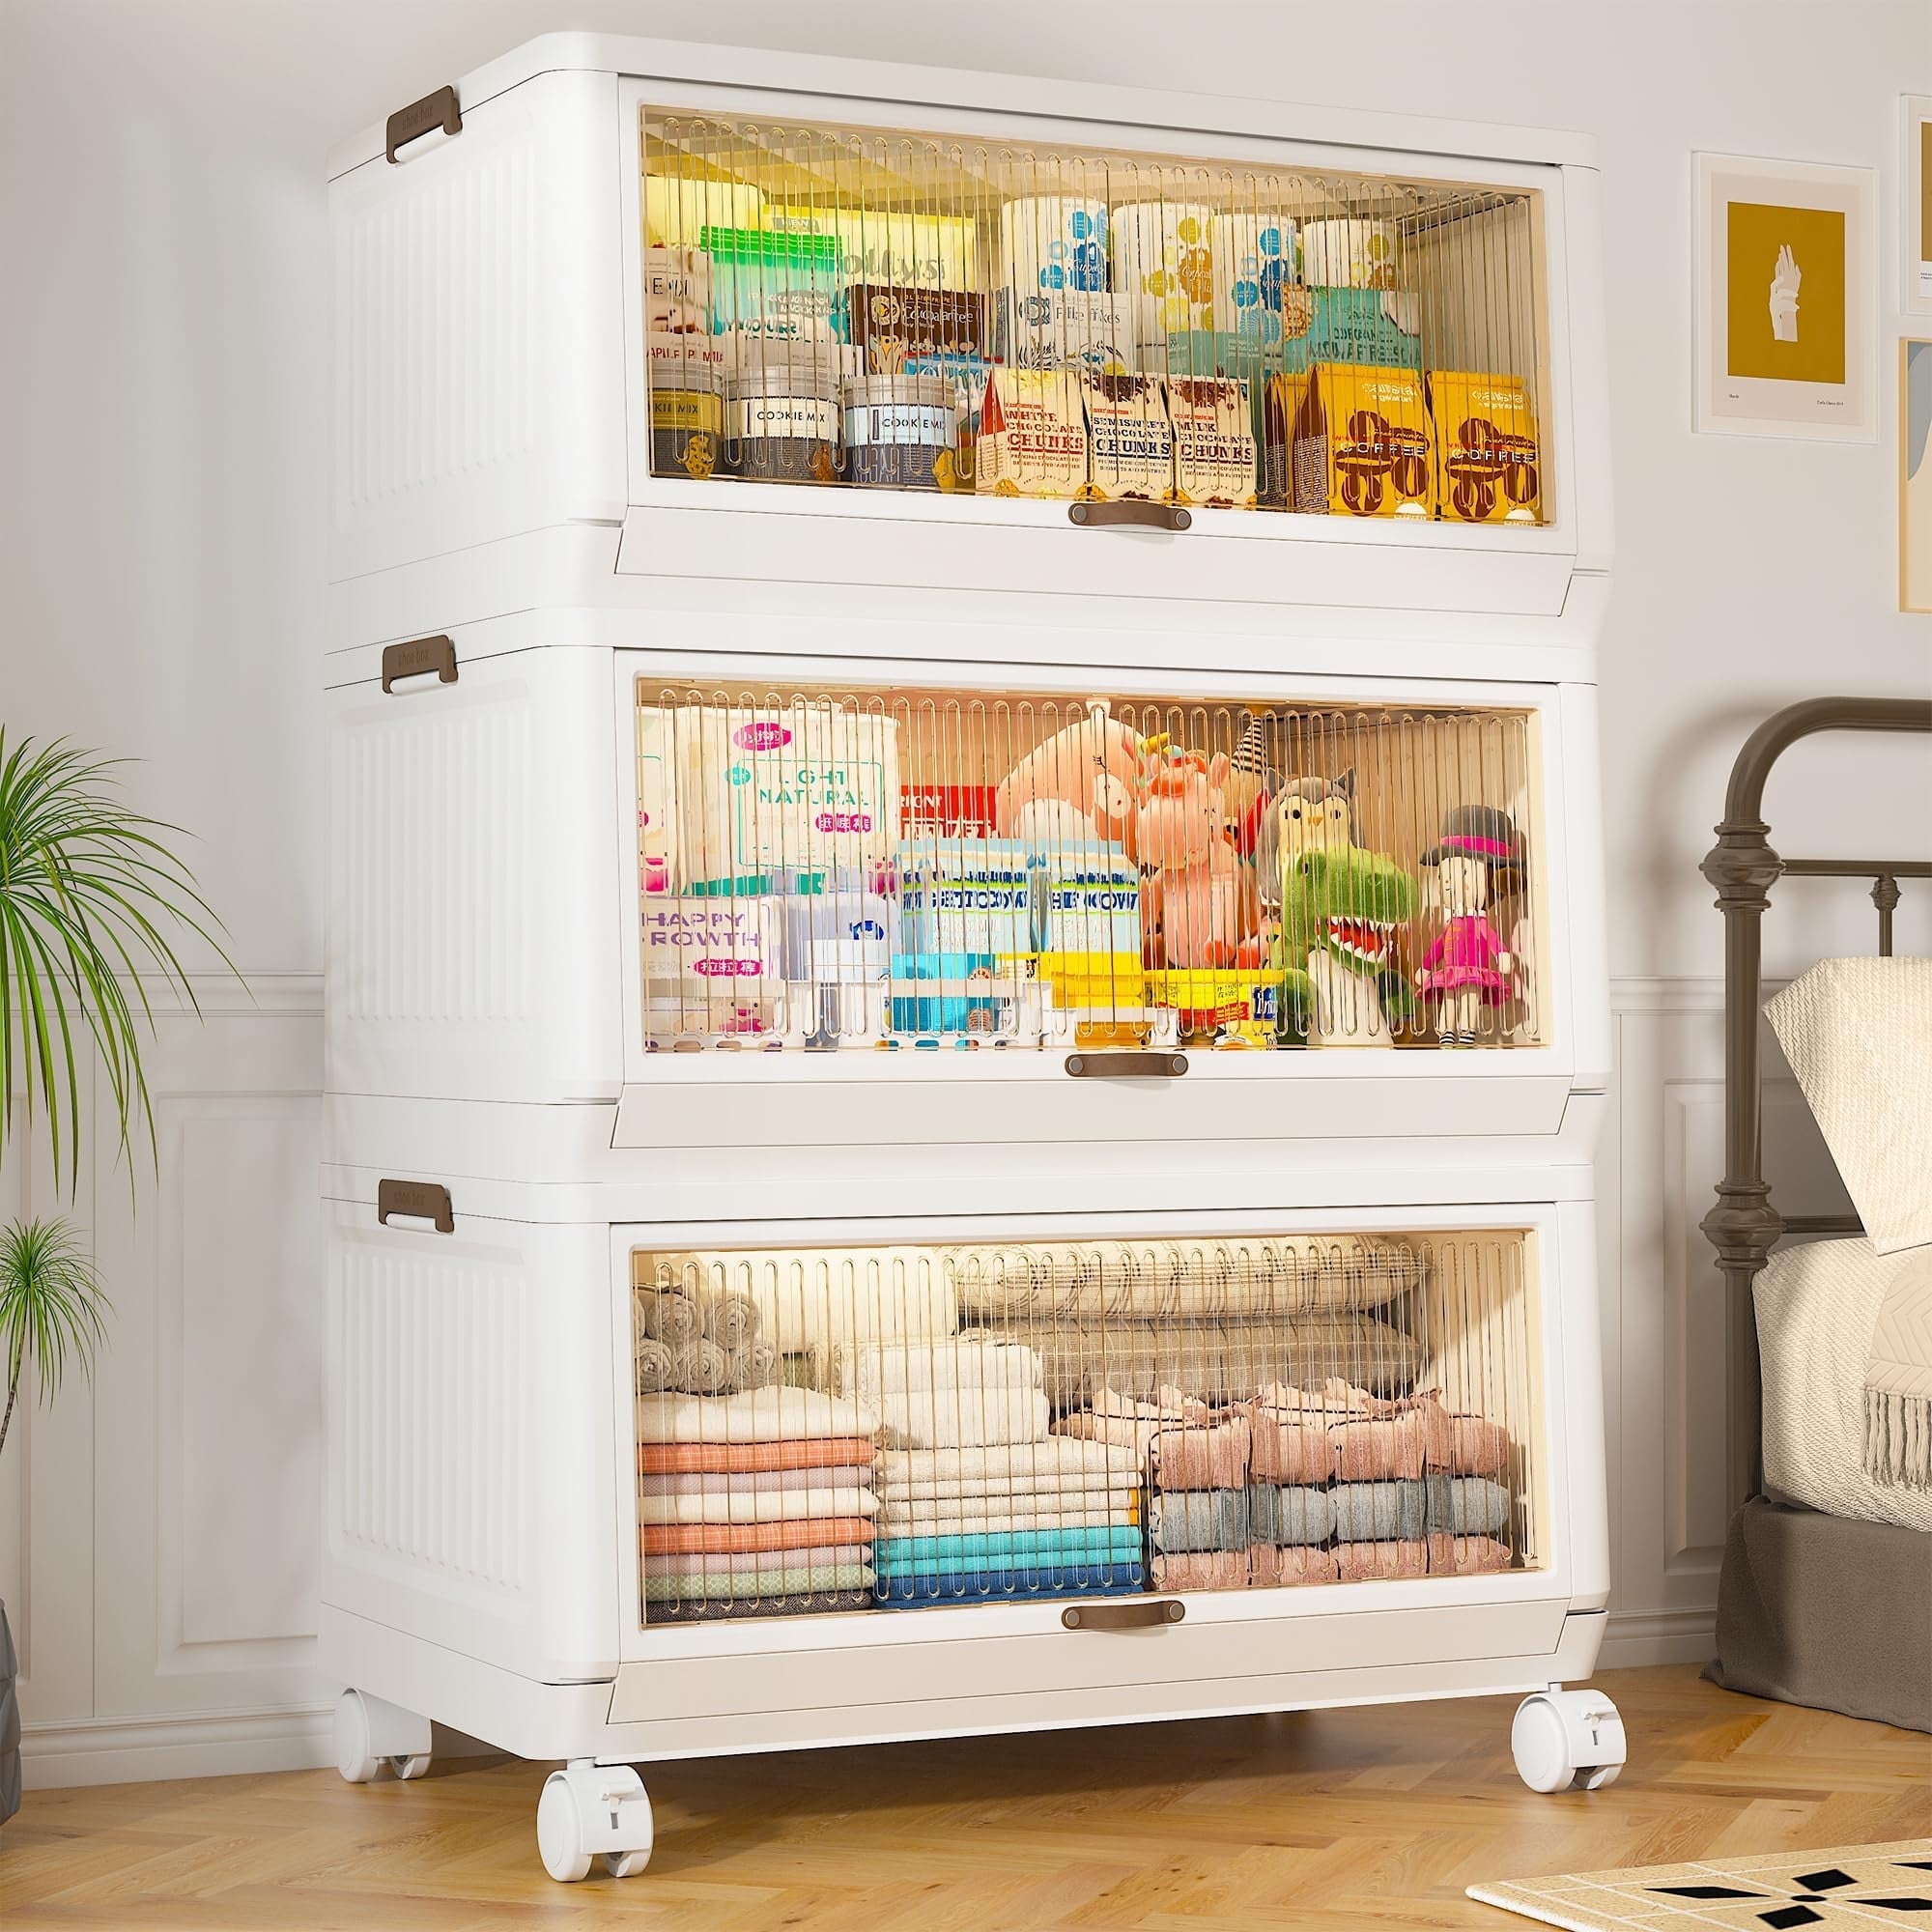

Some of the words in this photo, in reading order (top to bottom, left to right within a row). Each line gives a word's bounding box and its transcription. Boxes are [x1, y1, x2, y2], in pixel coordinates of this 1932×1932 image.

[756, 411, 804, 421] COOKIE
[807, 412, 825, 423] MX
[882, 417, 929, 429] COOKE
[1005, 410, 1057, 423] WHITE
[1093, 417, 1166, 429] SEMISWEET
[1094, 427, 1169, 440] CHOCOLATE
[1178, 421, 1216, 433] MILK
[1008, 434, 1084, 449] CHUNKS
[1179, 433, 1253, 445] CHOCOLATE
[1095, 439, 1170, 454] CHUNKS
[1180, 443, 1253, 459] CHUNKS
[1340, 442, 1426, 457] COFFEE
[1451, 448, 1536, 464] COFFEE
[779, 769, 845, 784] LGHT
[759, 788, 869, 806] NATURAL
[641, 913, 744, 927] HAPPY
[641, 931, 760, 947] ROWTH
